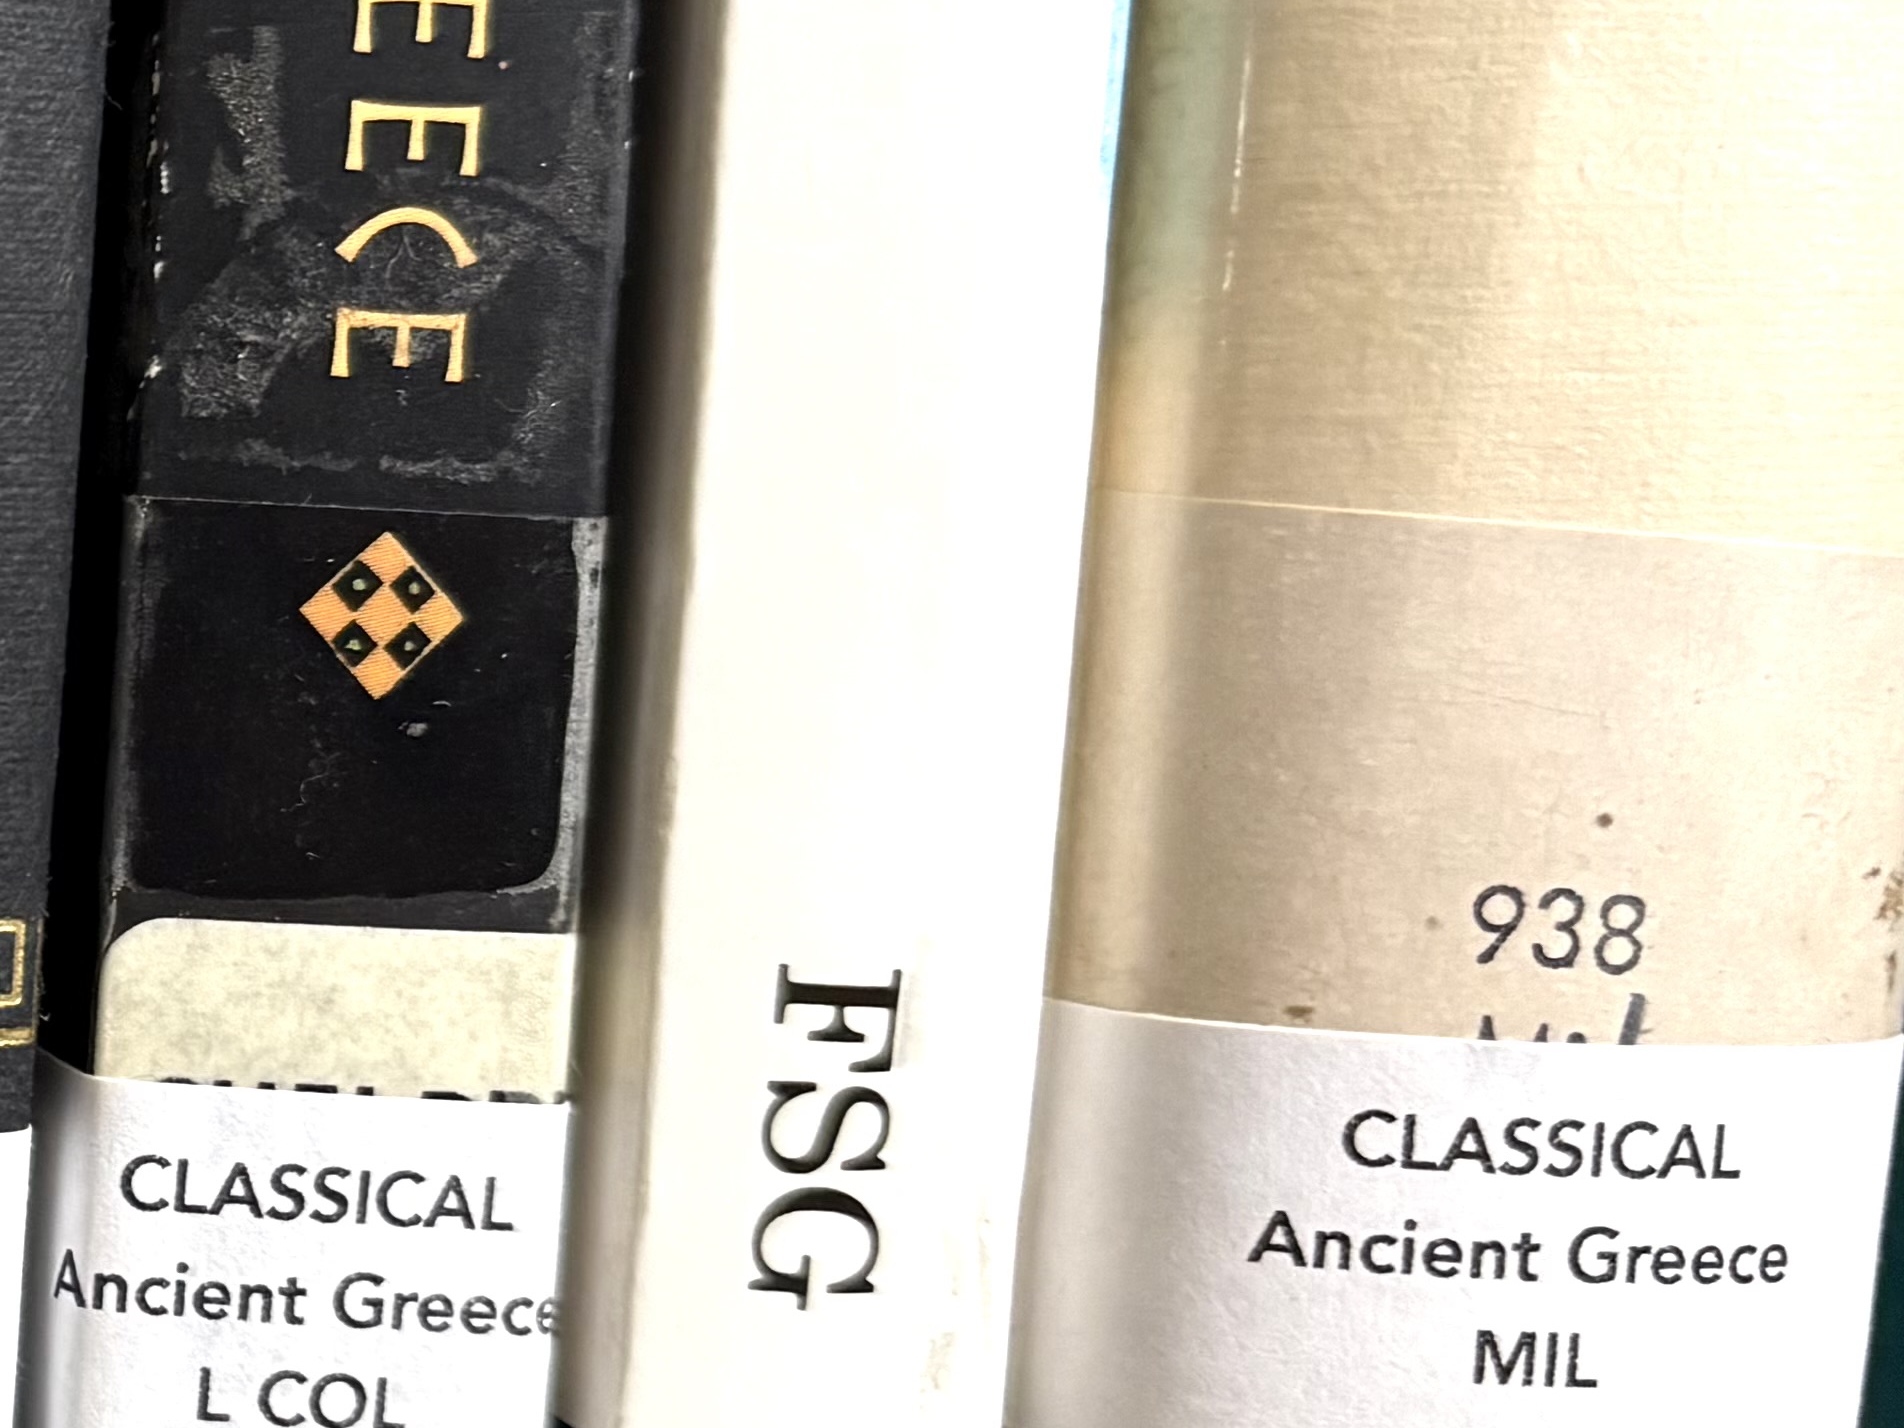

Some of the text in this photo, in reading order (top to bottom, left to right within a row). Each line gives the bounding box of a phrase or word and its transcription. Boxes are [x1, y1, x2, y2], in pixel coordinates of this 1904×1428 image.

[1472, 883, 1647, 976] 938
[747, 962, 904, 1312] FSG
[1340, 1107, 1742, 1181] CLASSICAL
[118, 1153, 516, 1233] CLASSICAL
[1245, 1208, 1789, 1287] Ancient Greece
[51, 1246, 562, 1336] Ancient Greece
[195, 1365, 232, 1424] L
[1472, 1328, 1599, 1390] MIL
